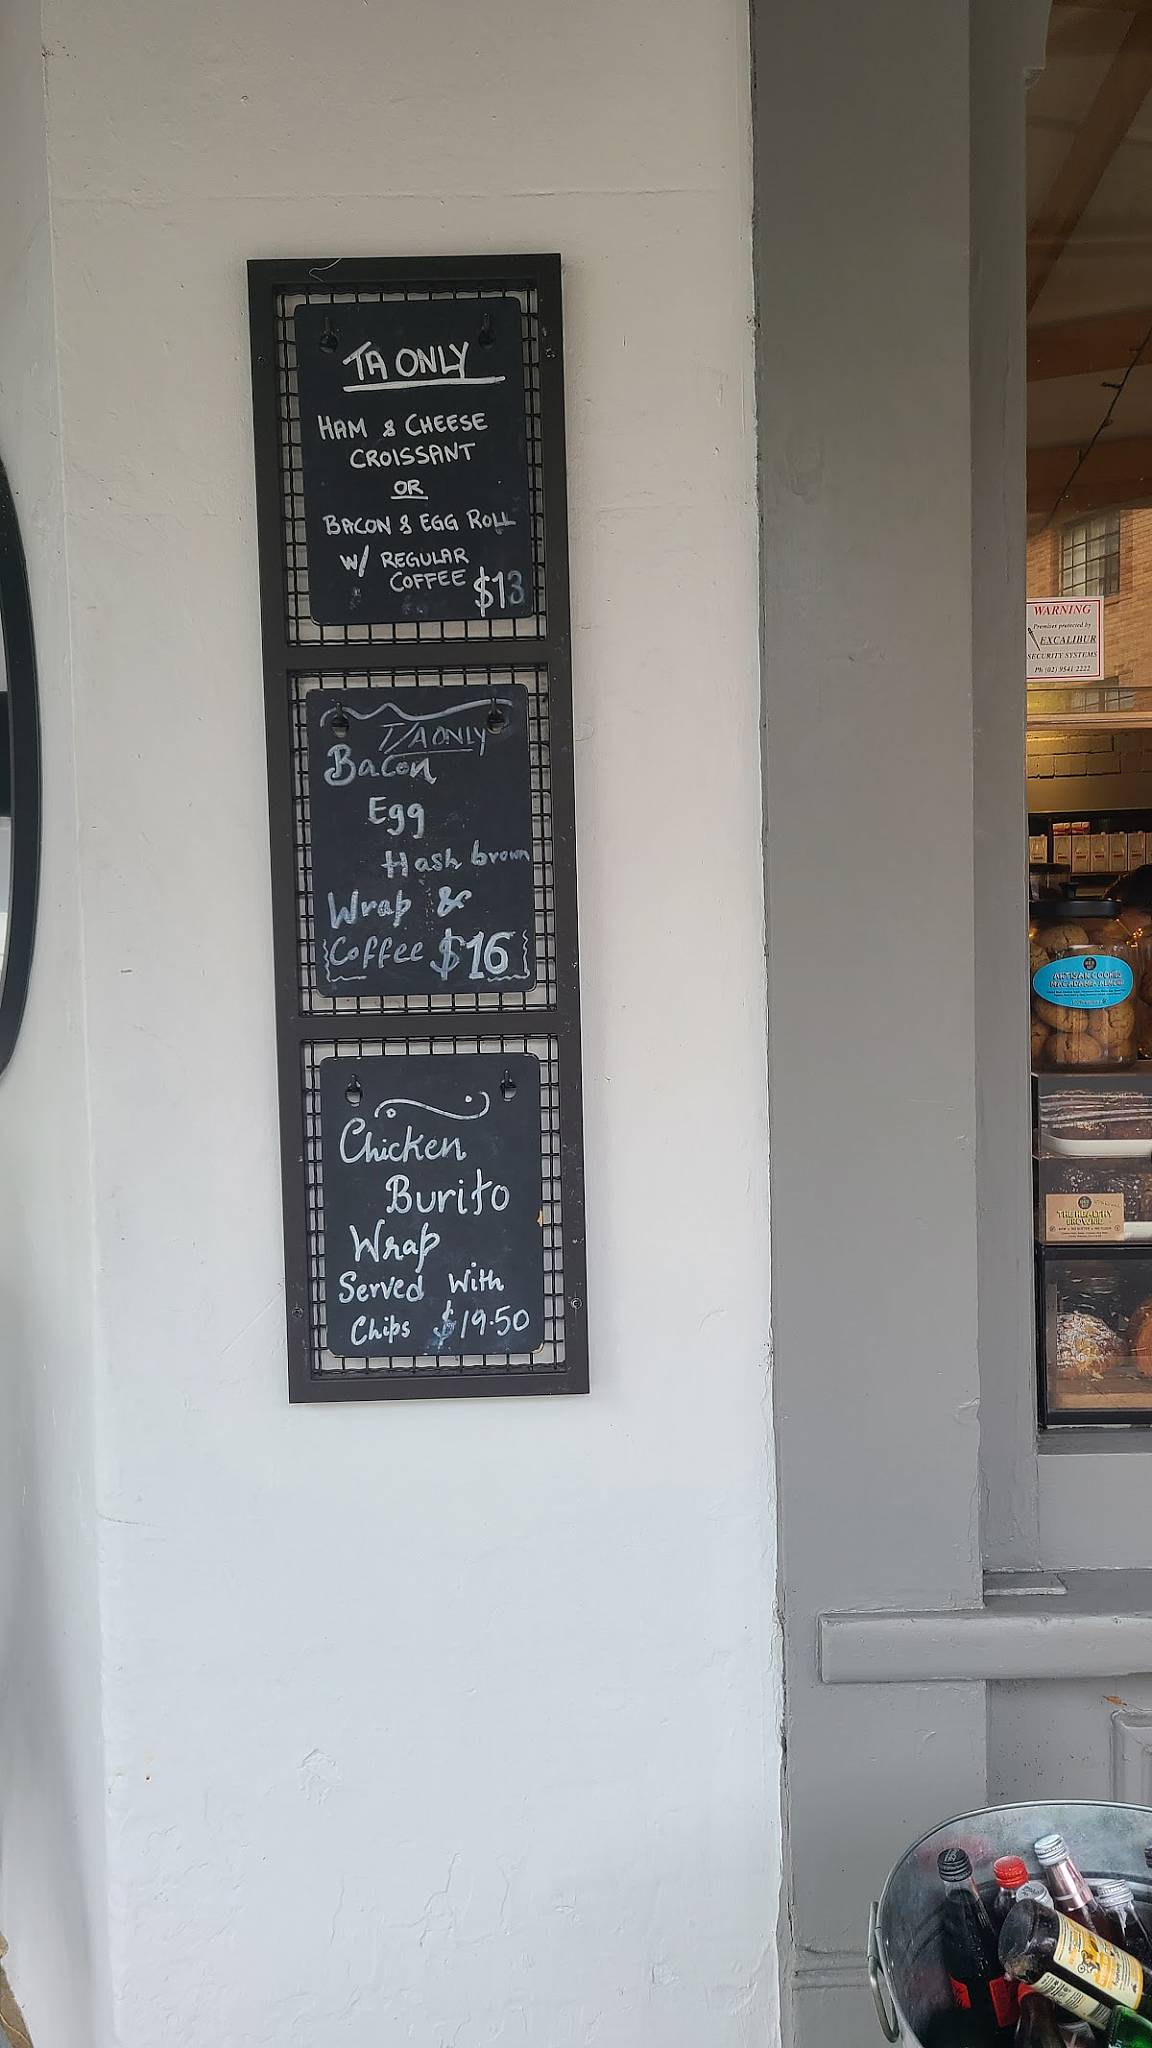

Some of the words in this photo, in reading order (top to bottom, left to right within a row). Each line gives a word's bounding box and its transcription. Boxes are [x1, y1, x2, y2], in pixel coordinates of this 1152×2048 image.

[395, 341, 470, 379] ONLY
[317, 414, 368, 441] HAM
[382, 419, 397, 438] &
[404, 412, 488, 437] CHEESE
[349, 442, 476, 469] CROISSANT
[393, 479, 425, 496] OR
[322, 513, 392, 536] BACON
[400, 513, 412, 535] &
[420, 513, 459, 532] EGG
[466, 508, 517, 532] ROLL
[380, 547, 470, 569] REGULAR
[389, 569, 466, 593] COFFEE
[473, 566, 525, 617] $13
[1034, 604, 1092, 616] WARNING
[1027, 652, 1064, 660] SECURITY
[1065, 651, 1098, 659] SYSTEMS
[1040, 635, 1097, 645] EXCALIBUR
[432, 726, 488, 757] ONLY
[324, 743, 437, 787] Bacon
[367, 796, 426, 840] Egg
[380, 848, 463, 879] Hash
[470, 839, 531, 868] brown
[327, 889, 412, 929] Wrap
[436, 885, 473, 918] &
[329, 935, 424, 970] Coffee
[429, 927, 517, 981] $16
[339, 1117, 467, 1164] Chicken
[385, 1168, 511, 1216] Burito
[350, 1218, 441, 1274] Wrap
[339, 1270, 425, 1304] Served
[350, 1314, 411, 1346] Chips
